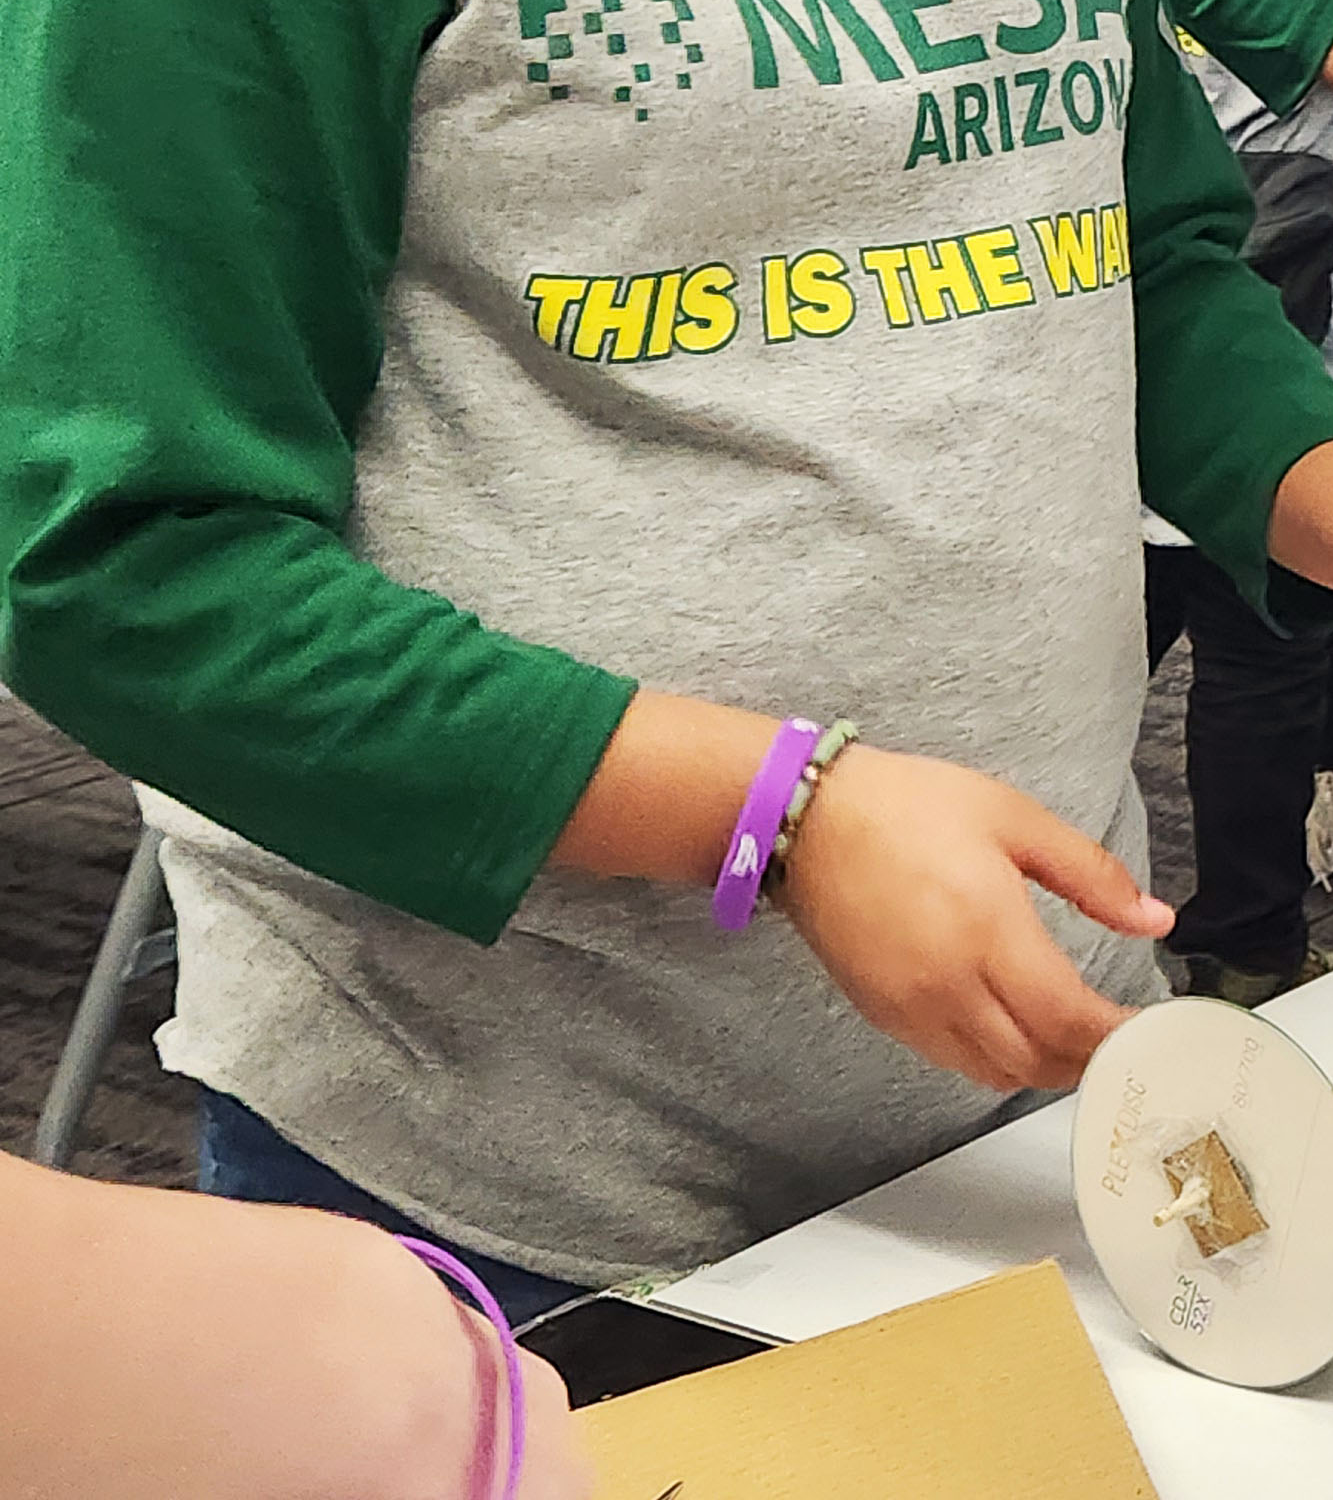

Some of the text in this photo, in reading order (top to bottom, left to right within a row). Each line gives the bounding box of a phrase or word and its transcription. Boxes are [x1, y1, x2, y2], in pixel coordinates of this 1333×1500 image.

[527, 262, 741, 364] THIS
[761, 247, 856, 345] IS
[860, 226, 1037, 330] THE
[1168, 1273, 1195, 1327] CD-R
